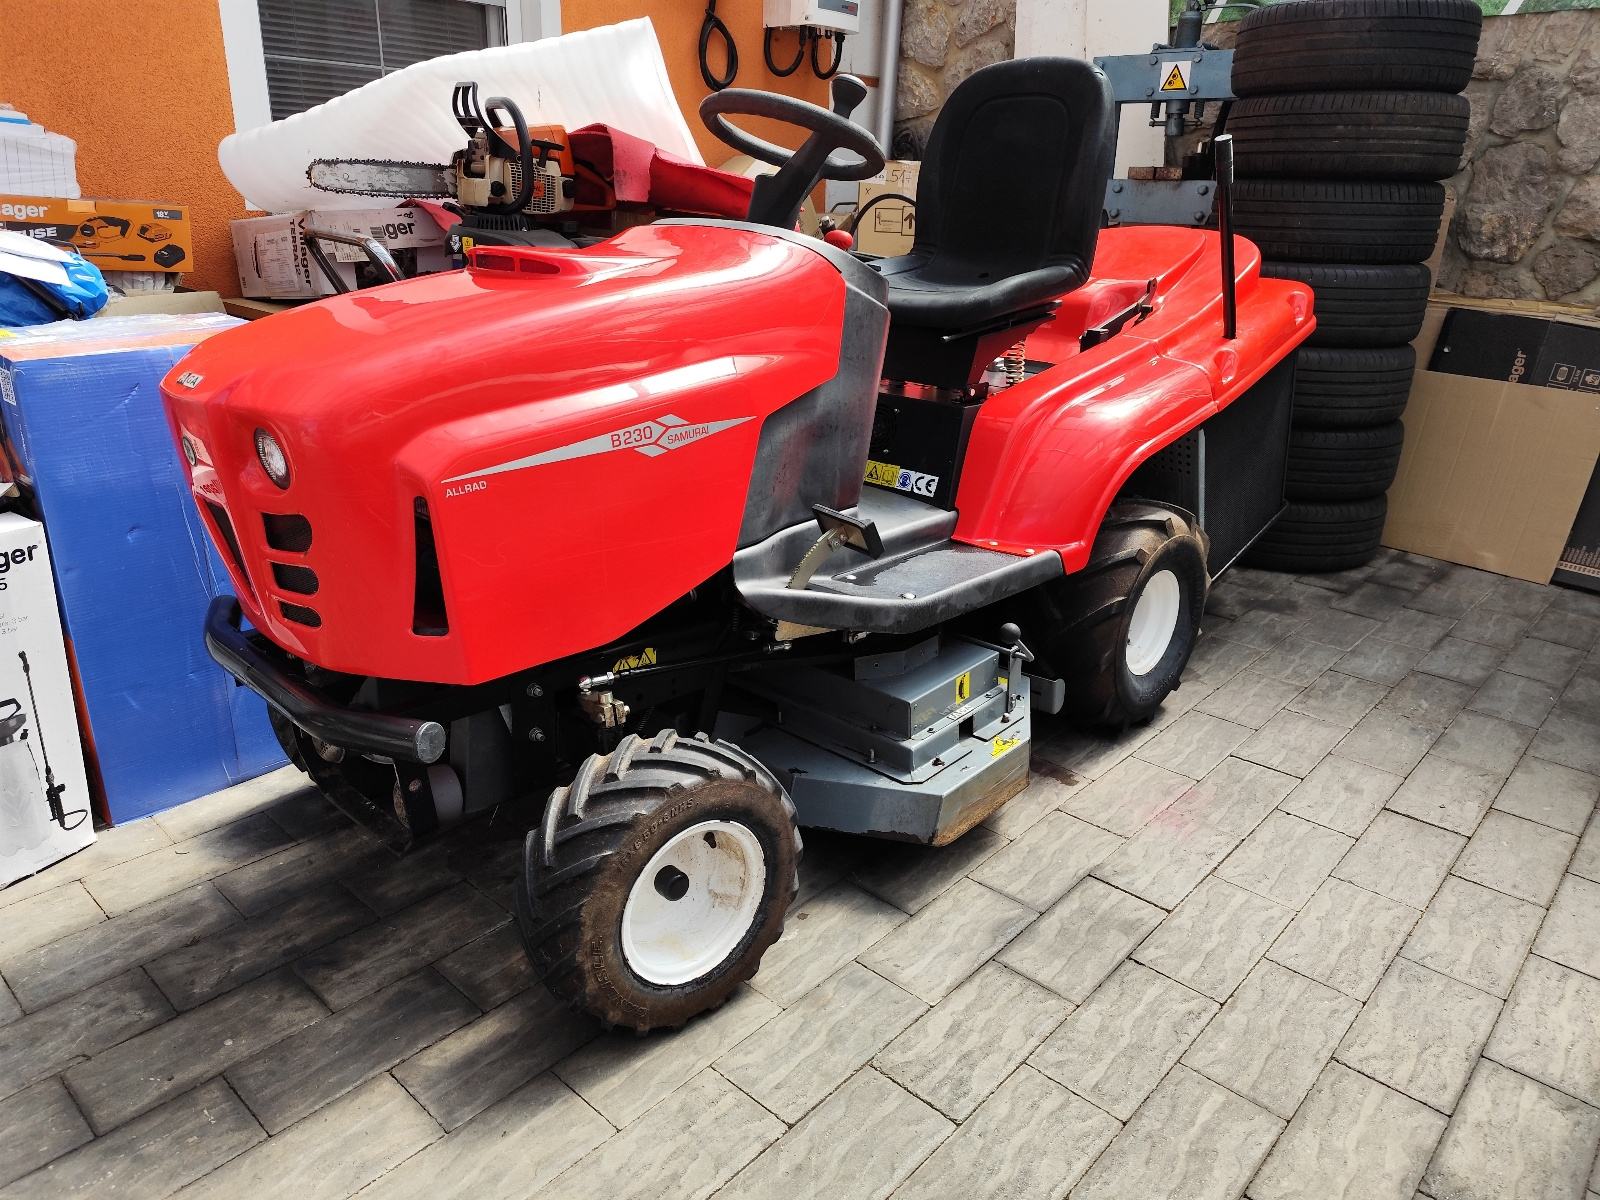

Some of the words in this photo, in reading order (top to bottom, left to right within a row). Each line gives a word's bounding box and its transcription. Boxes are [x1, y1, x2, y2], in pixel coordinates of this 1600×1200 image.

[0, 204, 48, 220] ager
[15, 226, 58, 239] USE
[381, 221, 416, 239] ger
[1508, 350, 1527, 383] ager
[611, 425, 653, 449] B230
[667, 424, 710, 445] SAMURAI
[446, 480, 488, 499] ALLRAD
[914, 475, 936, 494] CE
[0, 544, 39, 574] ger
